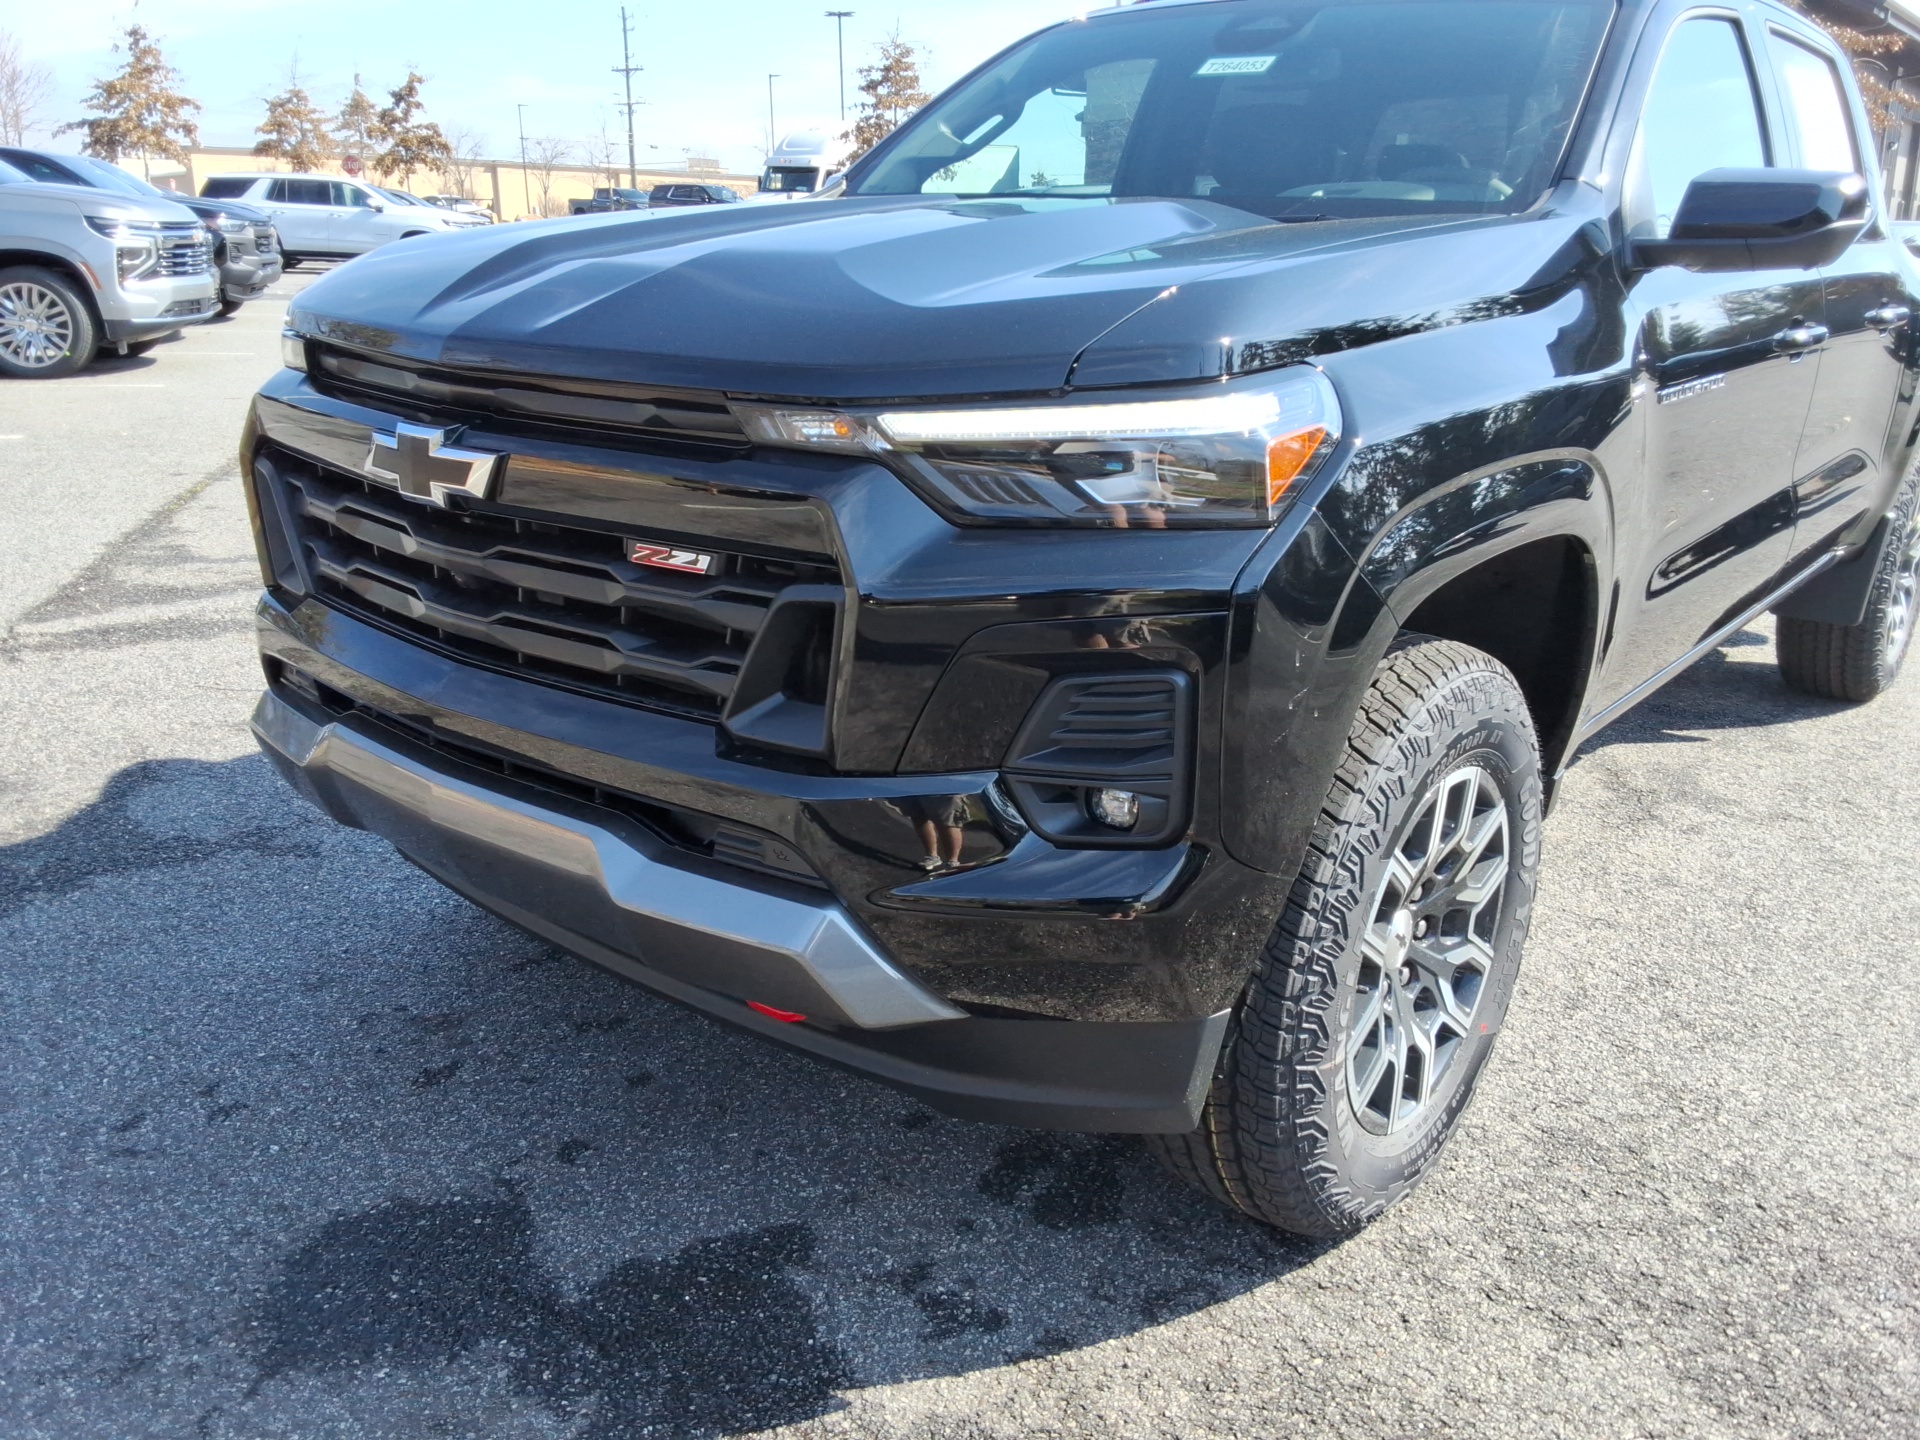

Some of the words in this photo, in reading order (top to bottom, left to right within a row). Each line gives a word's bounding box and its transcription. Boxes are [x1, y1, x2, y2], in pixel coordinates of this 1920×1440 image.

[1206, 60, 1267, 72] T264053
[631, 543, 711, 574] Z71
[1427, 730, 1488, 789] TERRITORY
